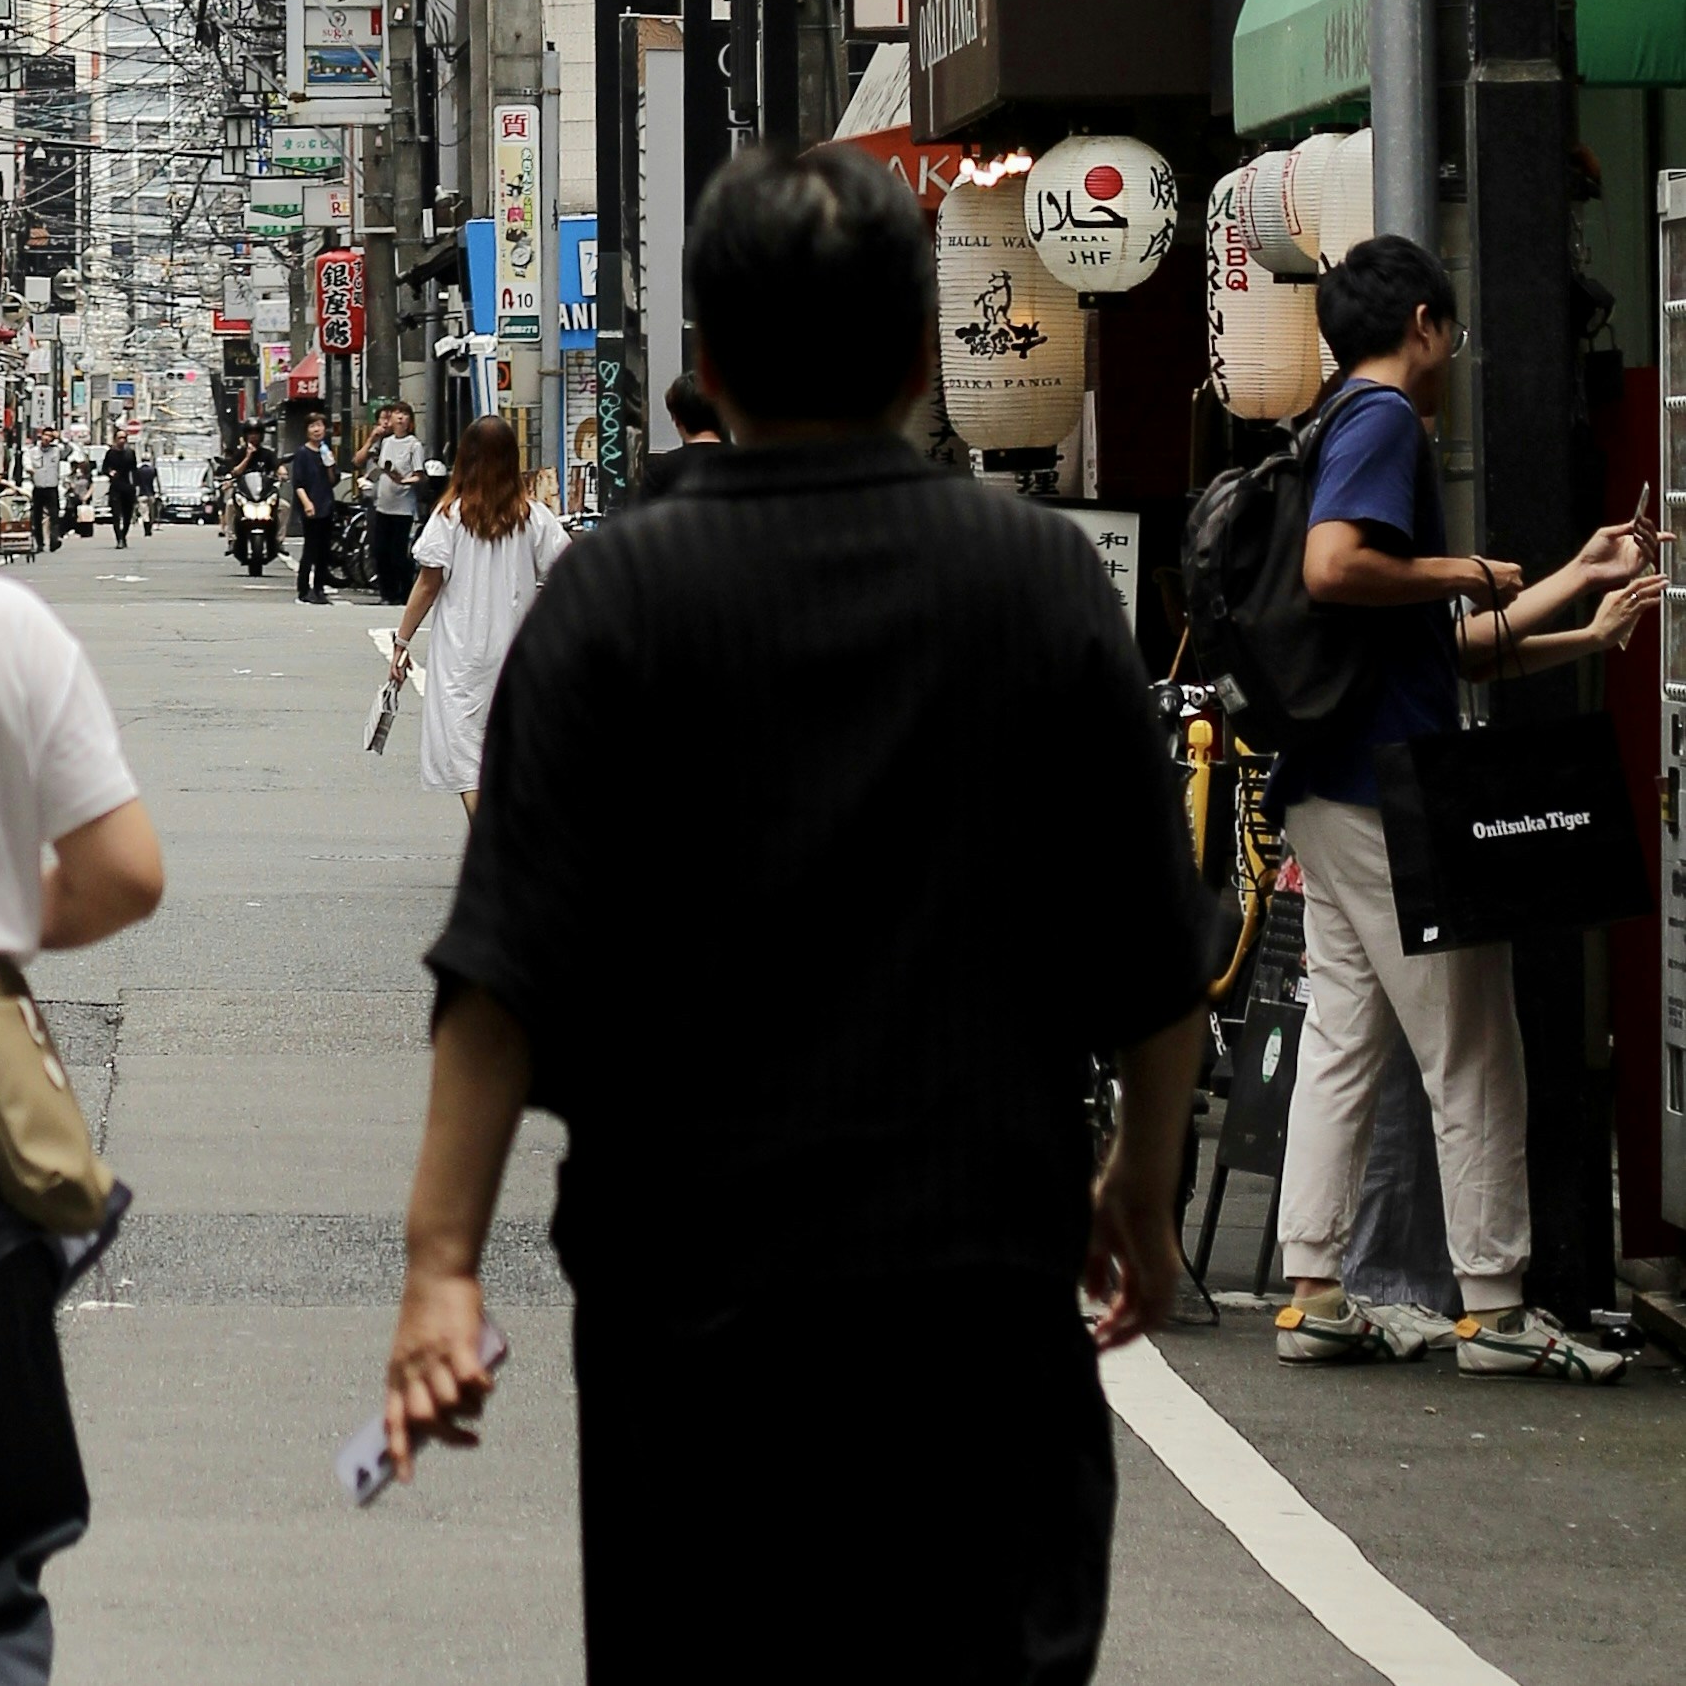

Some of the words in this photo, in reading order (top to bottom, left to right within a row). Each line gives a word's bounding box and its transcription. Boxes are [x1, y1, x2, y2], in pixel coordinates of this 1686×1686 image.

[502, 113, 529, 139] 質
[947, 235, 992, 249] HALAL
[1060, 234, 1110, 243] HALAL
[1067, 250, 1113, 266] JHF
[517, 293, 533, 309] 10
[1003, 376, 1063, 389] PANGA
[1472, 815, 1547, 839] Onitsuka
[1546, 811, 1591, 831] Tiger
